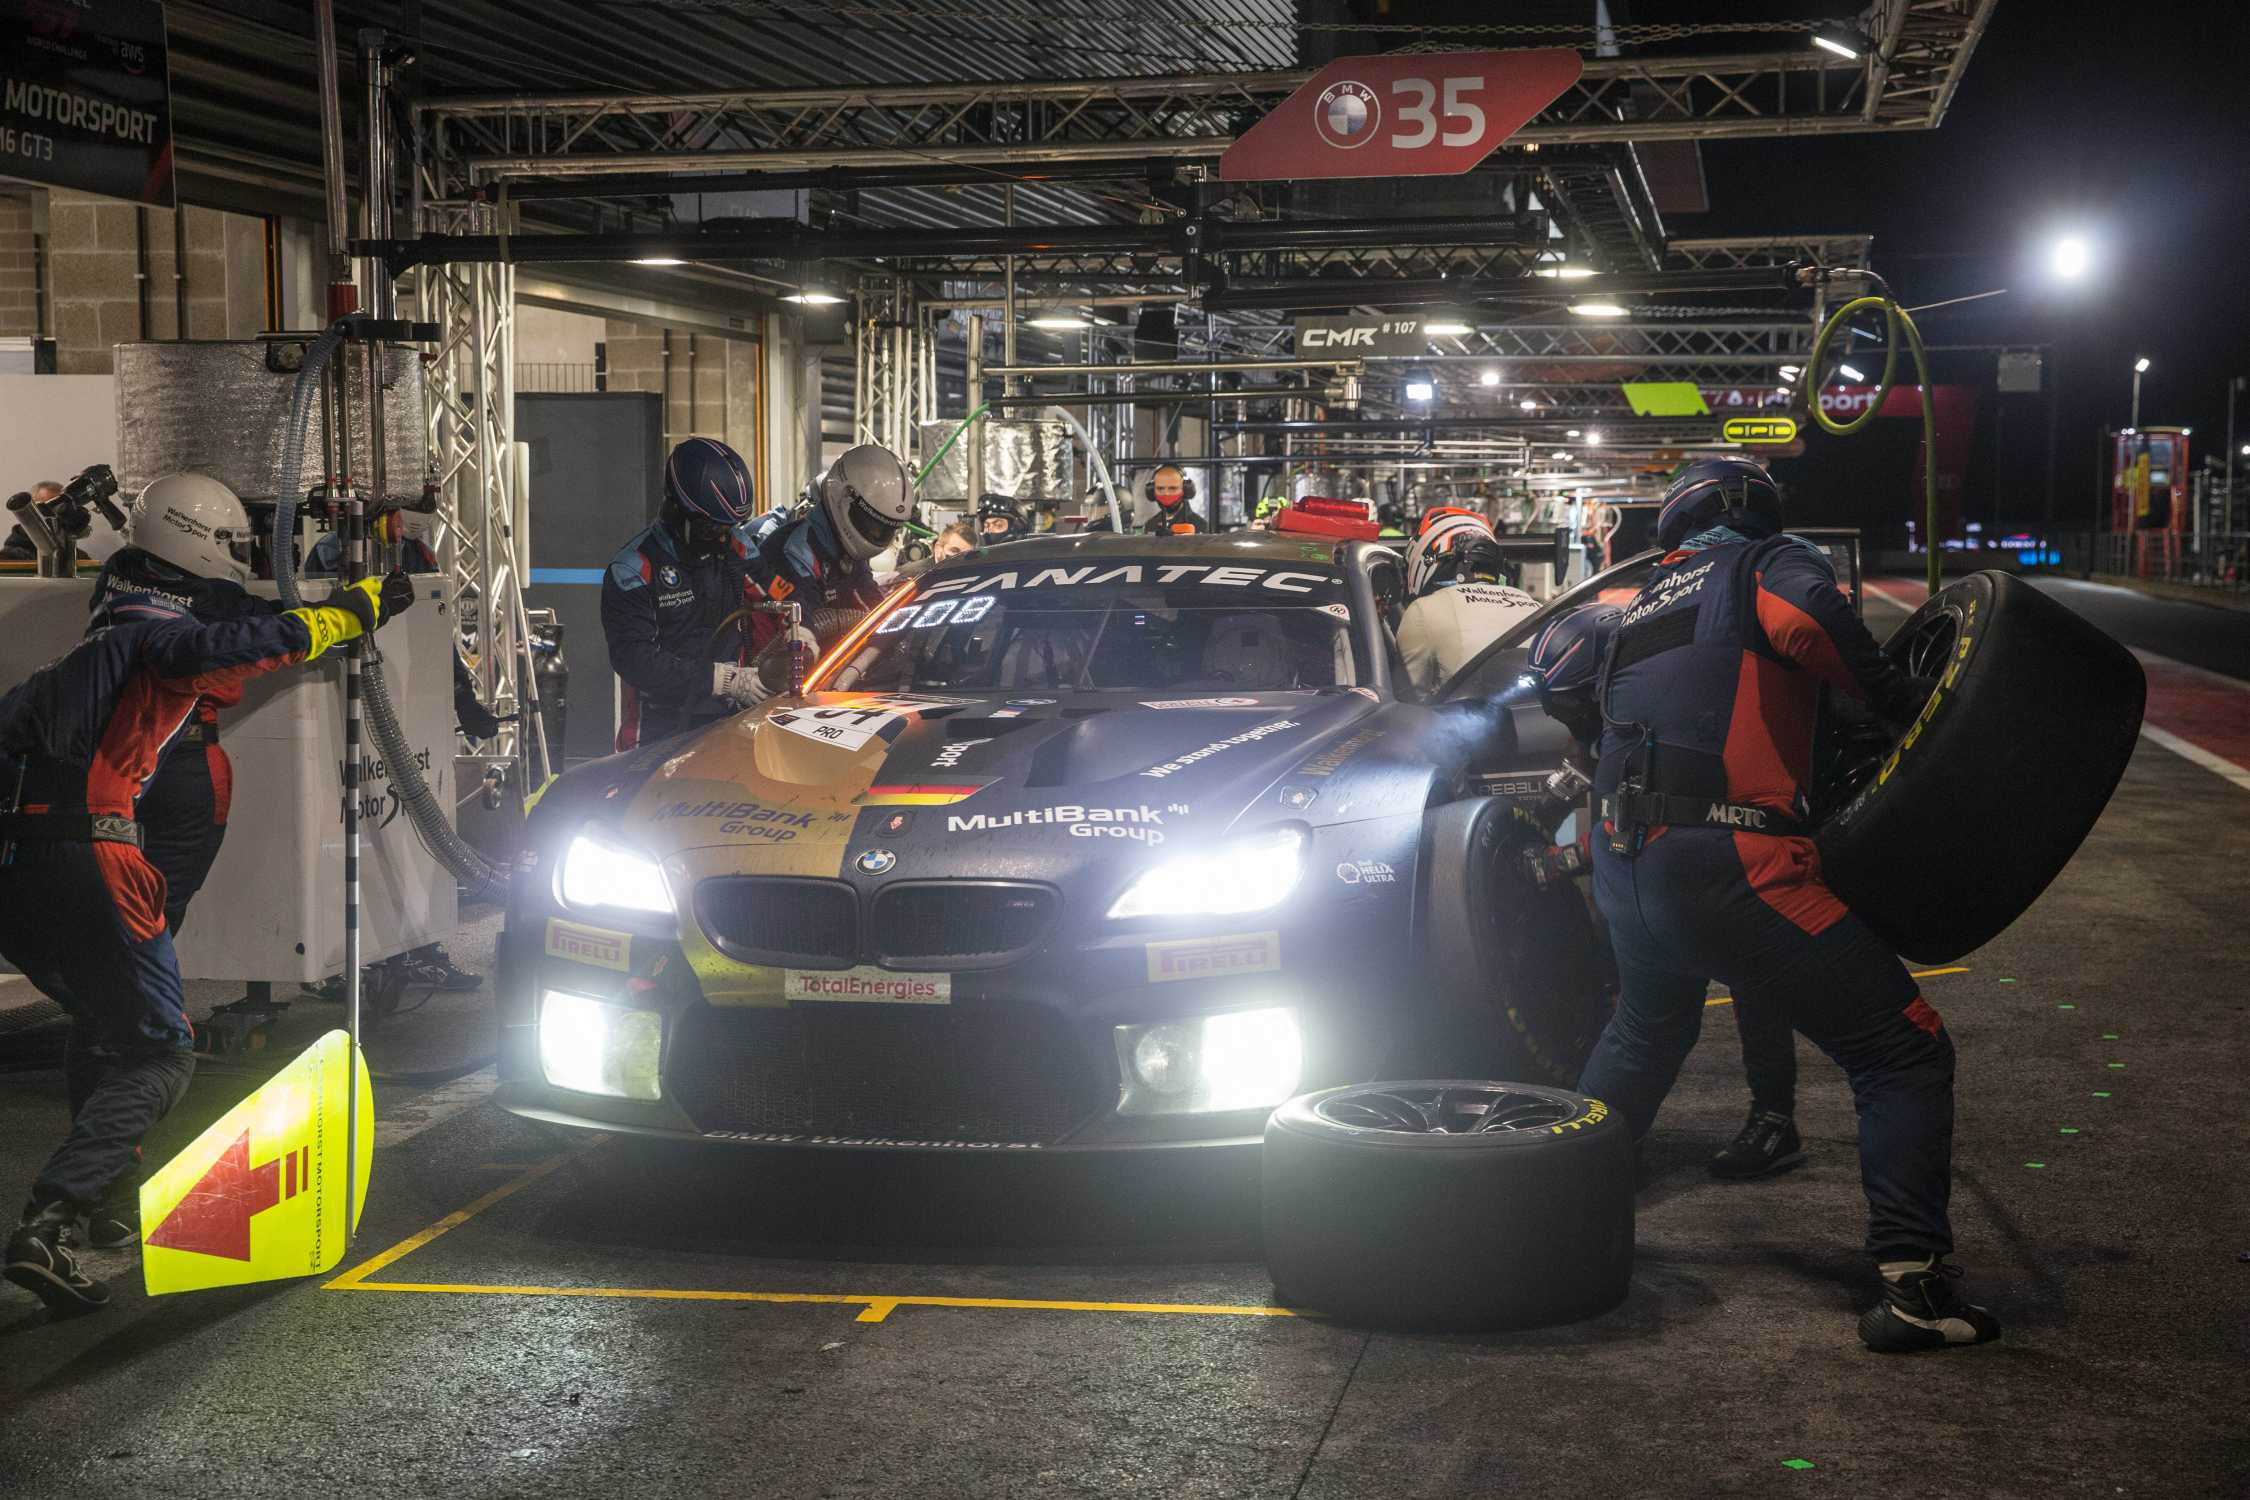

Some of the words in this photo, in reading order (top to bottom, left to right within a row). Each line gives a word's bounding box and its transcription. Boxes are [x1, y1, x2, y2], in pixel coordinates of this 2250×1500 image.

[1323, 84, 1372, 104] BMW
[5, 78, 157, 144] MOTORSPORT
[1391, 76, 1486, 149] 35
[21, 131, 54, 161] GT3
[1302, 327, 1379, 347] CMR
[1394, 321, 1417, 334] 107
[912, 565, 1329, 601] FANATEC
[812, 726, 844, 740] PRO
[1138, 763, 1183, 778] We
[651, 801, 817, 828] MultiBank
[947, 805, 1165, 832] MultiBank
[720, 821, 797, 842] Group
[1069, 823, 1165, 846] Group
[1359, 862, 1394, 874] HELIX
[1364, 873, 1396, 883] ULTRA
[552, 924, 623, 962] PIRELLI
[800, 976, 936, 999] TotalEnergies
